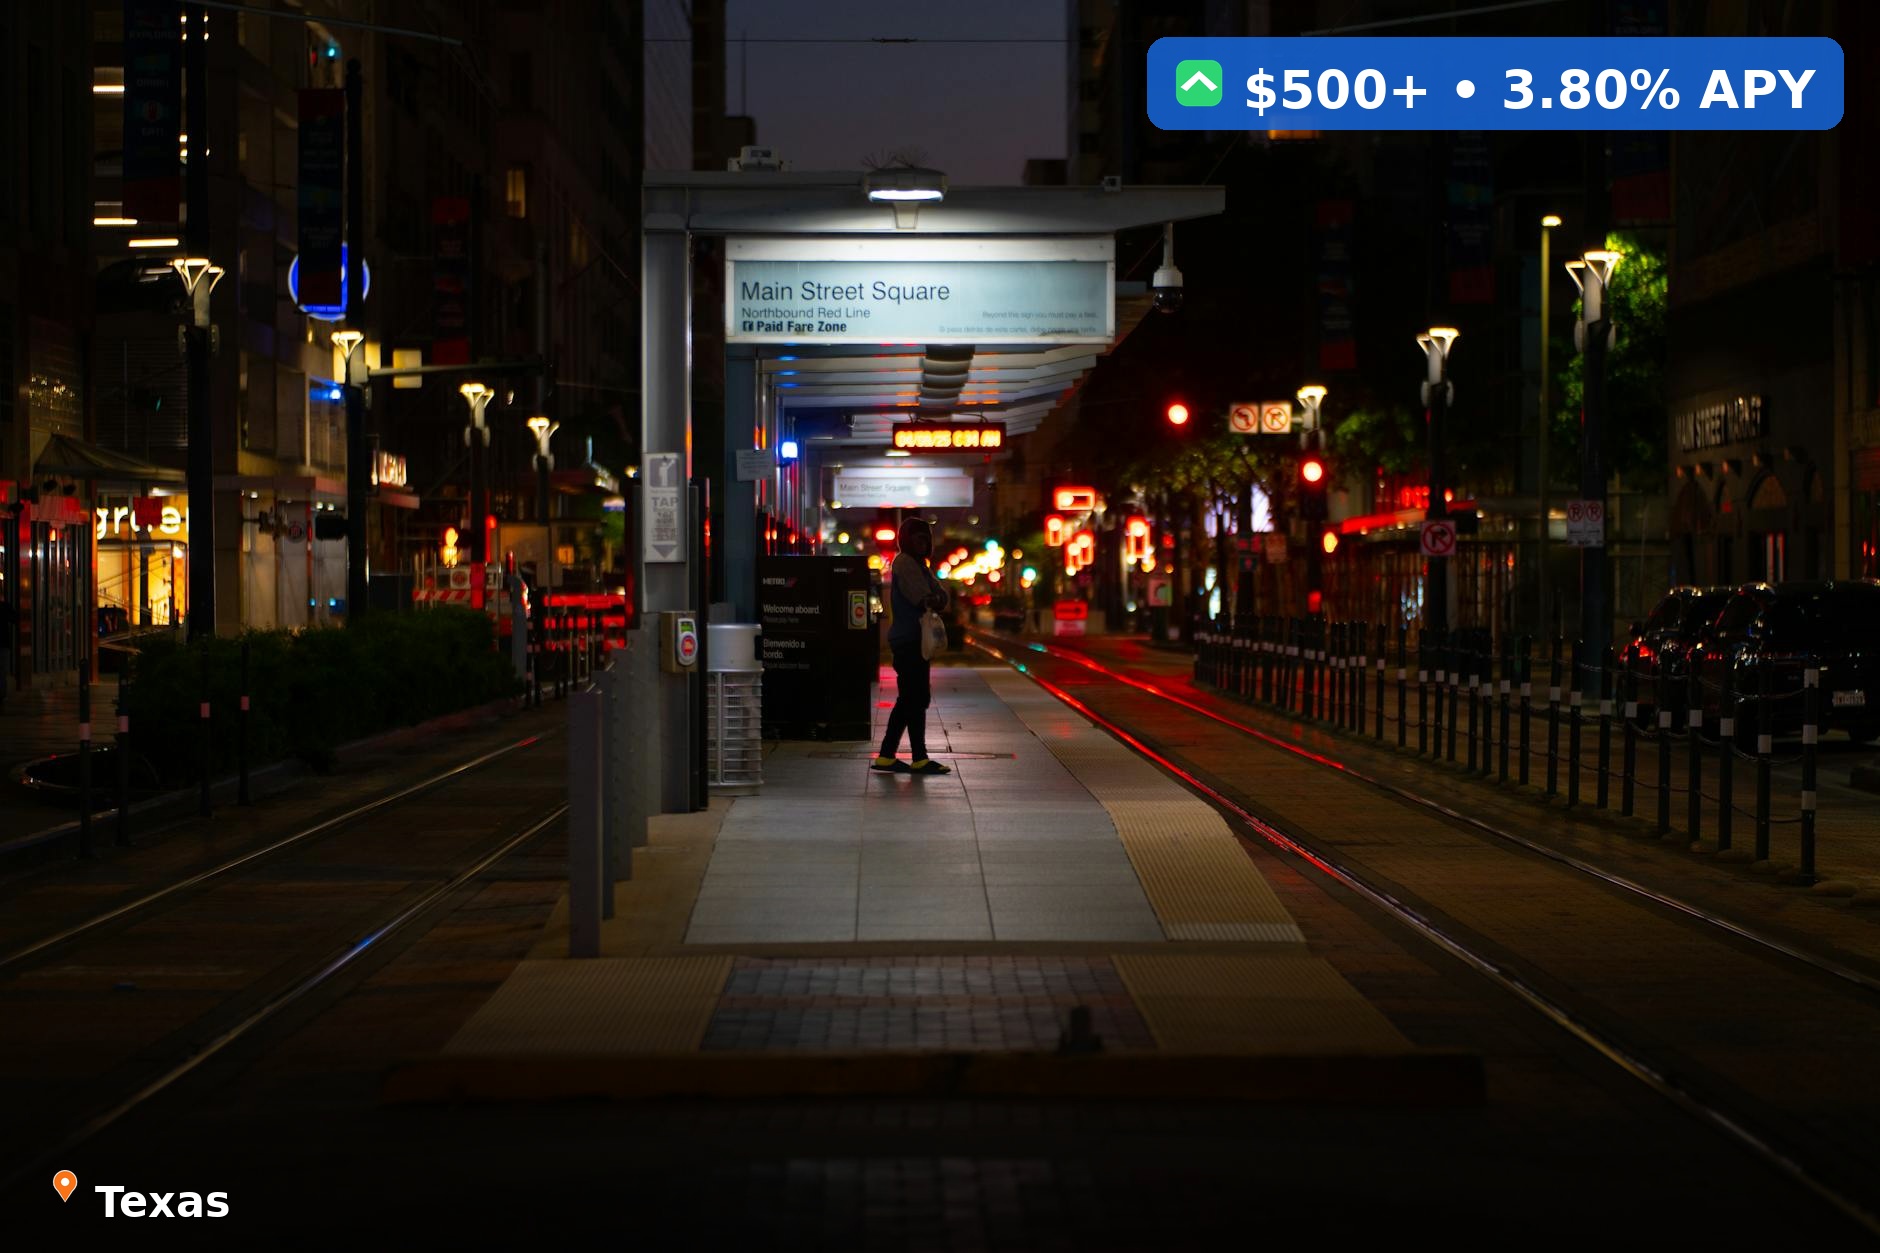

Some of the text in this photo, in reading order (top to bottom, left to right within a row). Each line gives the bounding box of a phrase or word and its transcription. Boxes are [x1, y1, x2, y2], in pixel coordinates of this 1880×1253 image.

[741, 281, 950, 304] Main Street Square
[741, 307, 871, 318] Northbound Red Line
[757, 321, 847, 332] Paid Fare Zone
[1695, 403, 1726, 449] STREET
[651, 497, 679, 507] TAP
[763, 604, 820, 614] Welcome aboard.
[763, 639, 800, 649] Bienvenido
[763, 651, 784, 660] bordo.
